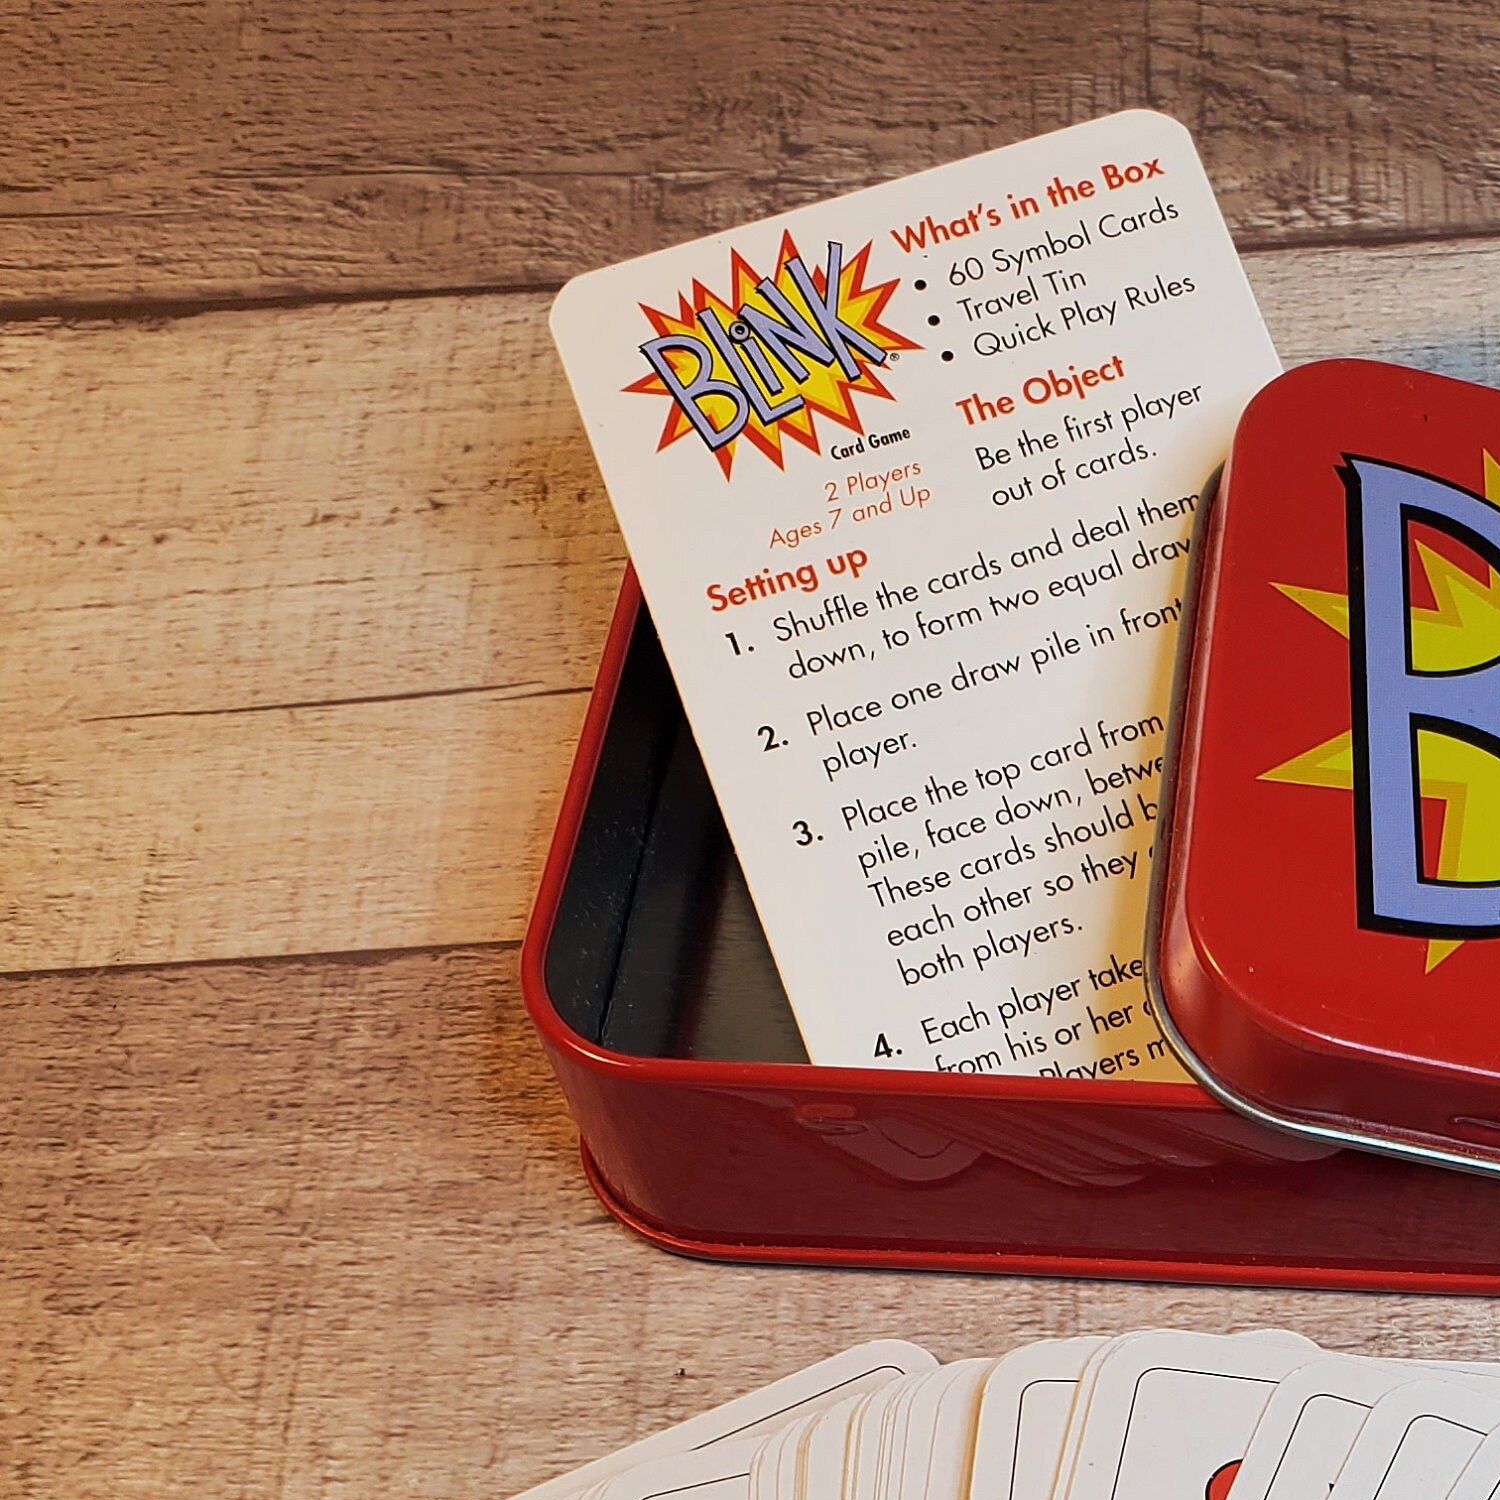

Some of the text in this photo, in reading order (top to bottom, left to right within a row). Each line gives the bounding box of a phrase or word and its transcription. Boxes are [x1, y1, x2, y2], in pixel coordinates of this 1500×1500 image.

[889, 158, 1165, 254] What's in the Box
[948, 195, 1179, 287] 60 Symbol Cards
[955, 269, 1087, 322] Travel Tin
[973, 274, 1196, 357] Quick Play Rules
[954, 355, 1125, 426] The Object
[974, 385, 1202, 471] Be the first player
[824, 462, 921, 502] 2 Players
[830, 428, 911, 461] Card Game
[992, 435, 1157, 506] out of cards.
[769, 485, 931, 549] Ages 7 and Up
[706, 549, 868, 612] Setting up
[724, 493, 1200, 656] 1. Shuffle the cards and deal them
[788, 643, 875, 679] down,
[881, 629, 910, 650] to
[915, 607, 983, 640] form
[988, 589, 1040, 617] two
[1048, 548, 1124, 598] equal
[757, 597, 1183, 753] 2. Place one draw pile in front
[792, 715, 1165, 847] 3. Place the top card from
[822, 732, 917, 783] player.
[857, 833, 919, 879] pile,
[924, 816, 988, 849] face
[995, 789, 1082, 826] down,
[866, 871, 952, 908] These
[959, 834, 1036, 880] cards
[1044, 798, 1135, 853] should
[887, 850, 1138, 947] each other so they
[896, 917, 1083, 987] both players.
[873, 1032, 903, 1059] 4.
[919, 1000, 991, 1045] Each
[997, 978, 1081, 1030] player
[1003, 1031, 1048, 1062] his
[1054, 1022, 1082, 1046] or
[1085, 1004, 1134, 1035] her
